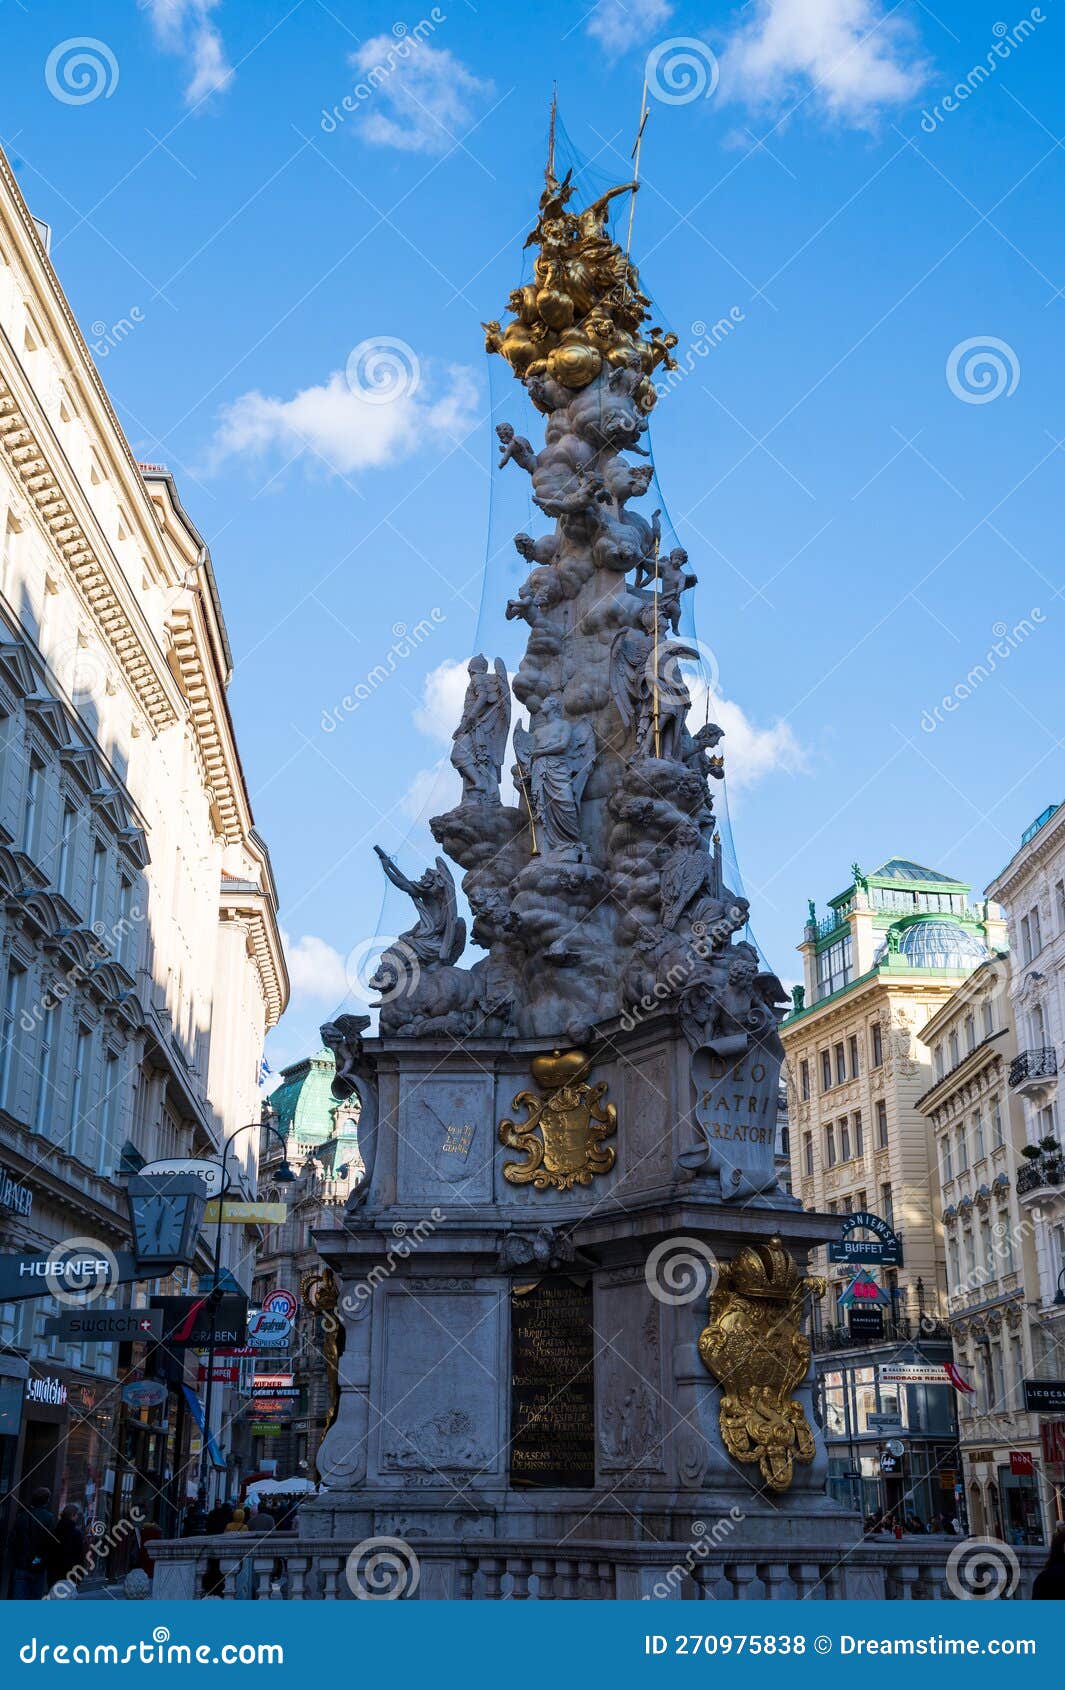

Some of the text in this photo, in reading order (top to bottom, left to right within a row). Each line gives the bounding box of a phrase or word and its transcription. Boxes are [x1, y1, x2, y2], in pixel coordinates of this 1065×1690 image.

[702, 1089, 769, 1114] PATRI
[845, 1243, 884, 1254] BUFFET
[20, 1260, 109, 1276] HÜBNER
[69, 1316, 139, 1332] swatch
[26, 1376, 62, 1405] swatch
